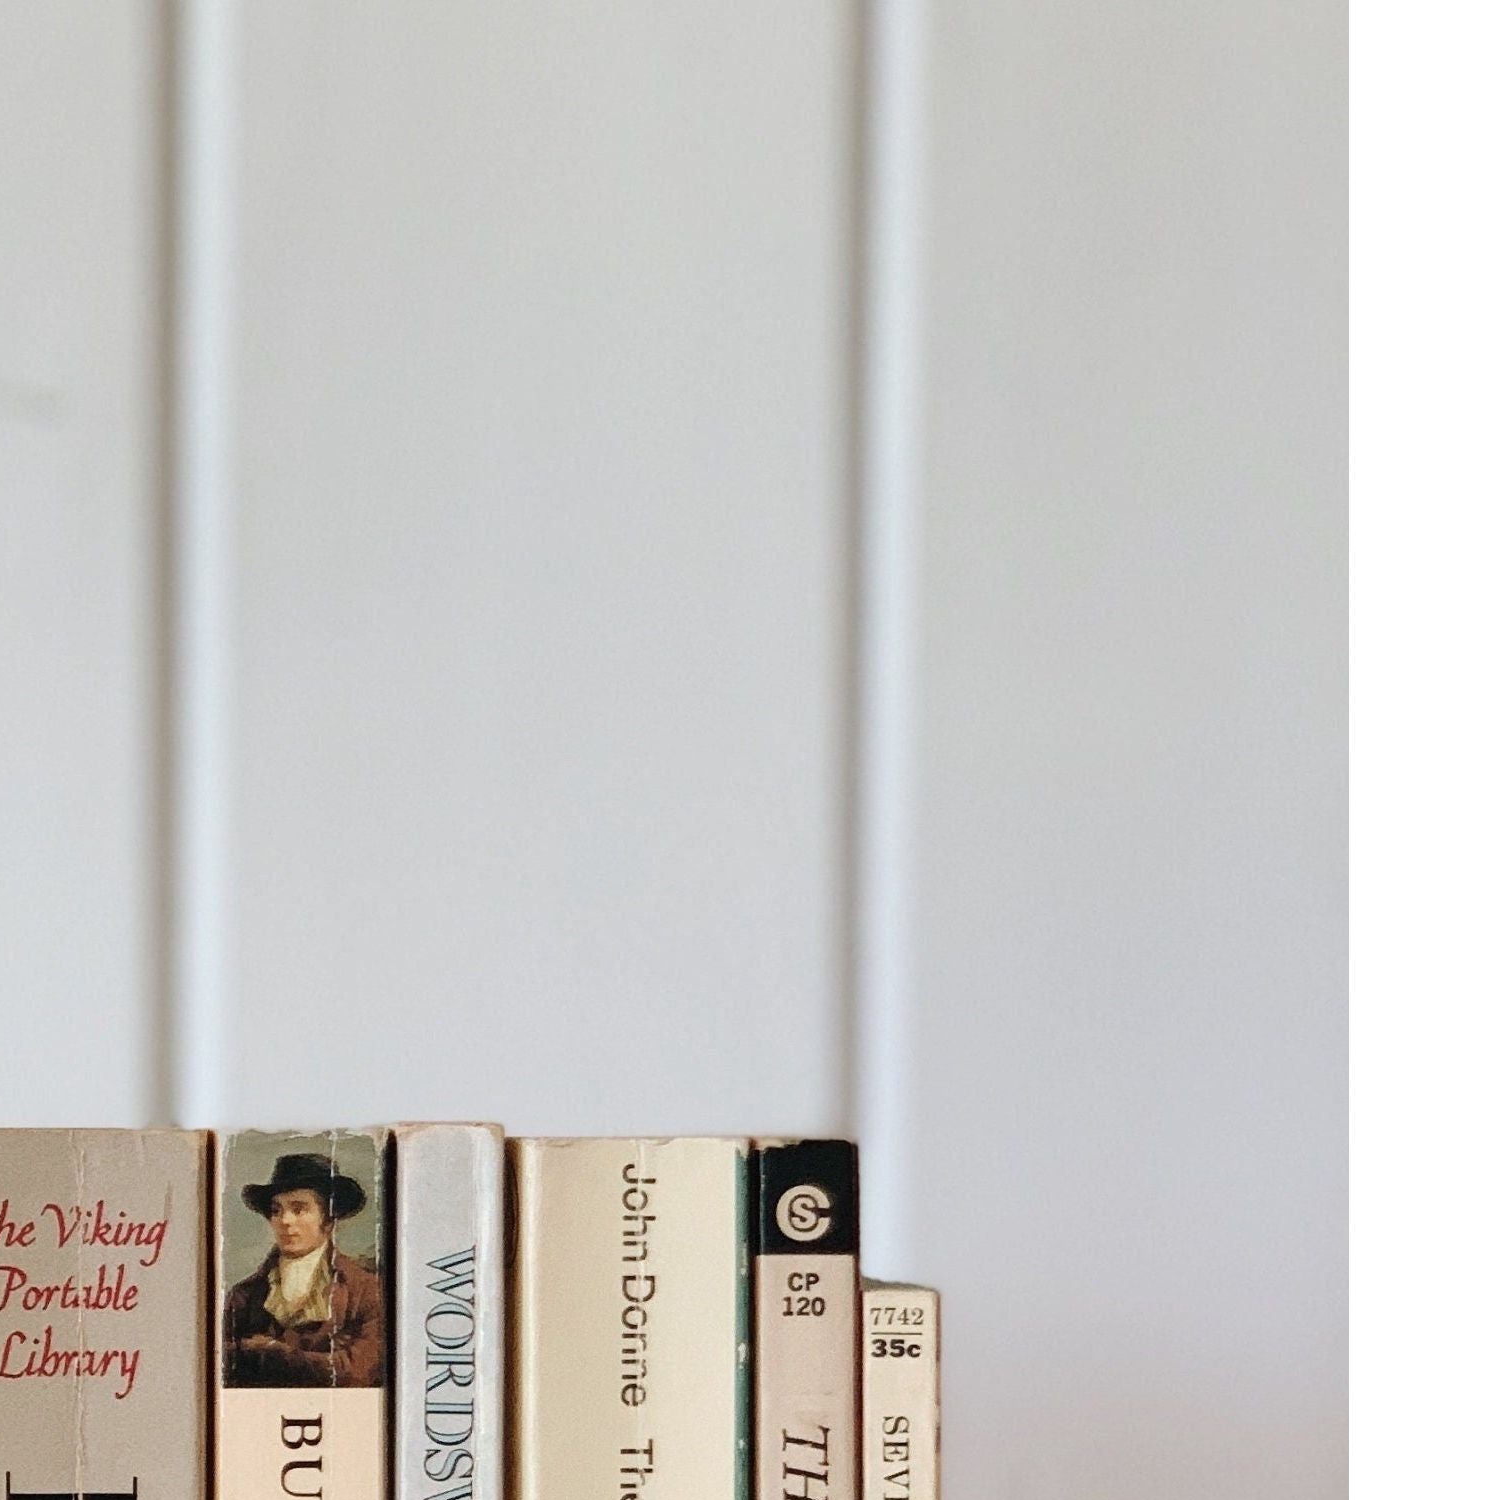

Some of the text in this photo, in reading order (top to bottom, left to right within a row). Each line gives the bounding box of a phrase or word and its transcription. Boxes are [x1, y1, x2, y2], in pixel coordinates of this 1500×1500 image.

[621, 1162, 657, 1263] John
[40, 1201, 169, 1266] Viking
[787, 1272, 820, 1292] CP
[782, 1297, 826, 1317] 120
[870, 1307, 924, 1326] 7742
[620, 1275, 657, 1408] Donne
[871, 1339, 921, 1357] 35c
